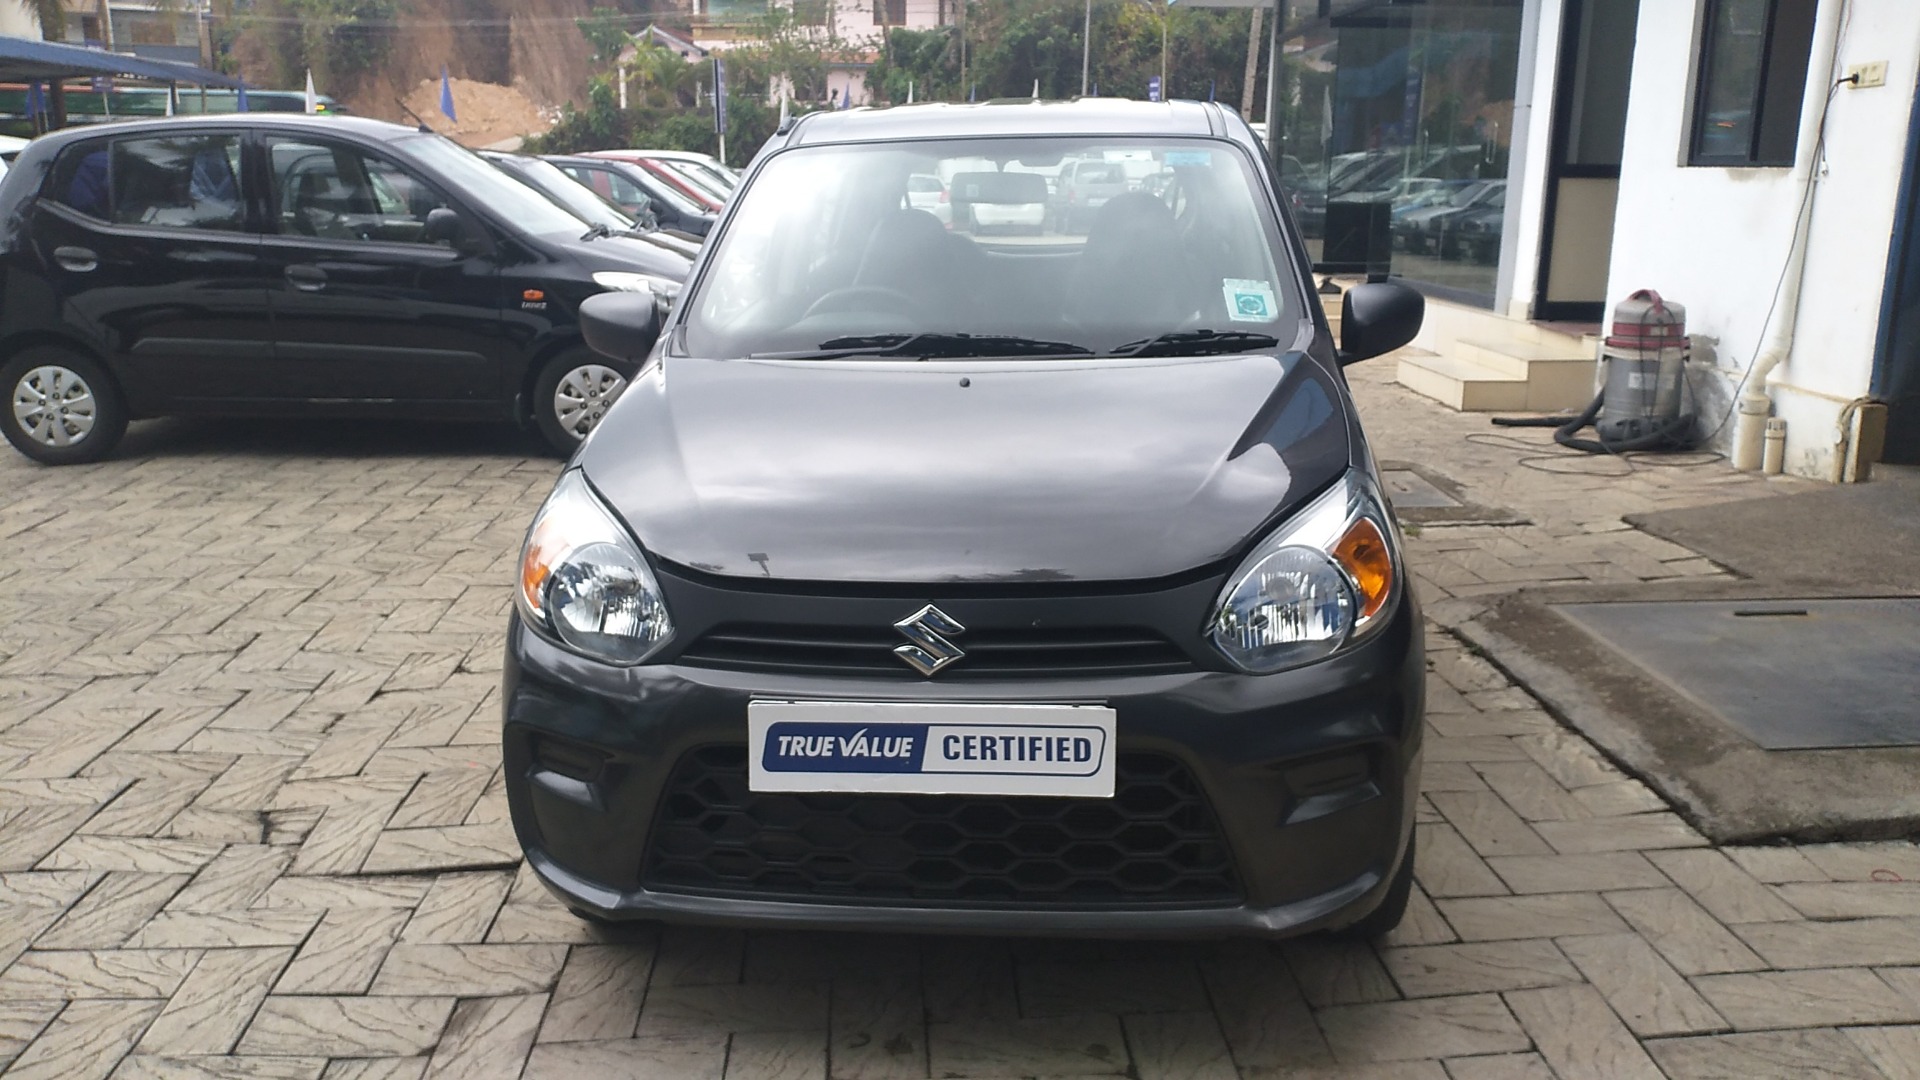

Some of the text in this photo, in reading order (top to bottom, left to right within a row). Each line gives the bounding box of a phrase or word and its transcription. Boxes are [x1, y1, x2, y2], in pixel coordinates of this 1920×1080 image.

[778, 729, 1091, 762] TRUE VALUE CERTIFIED
